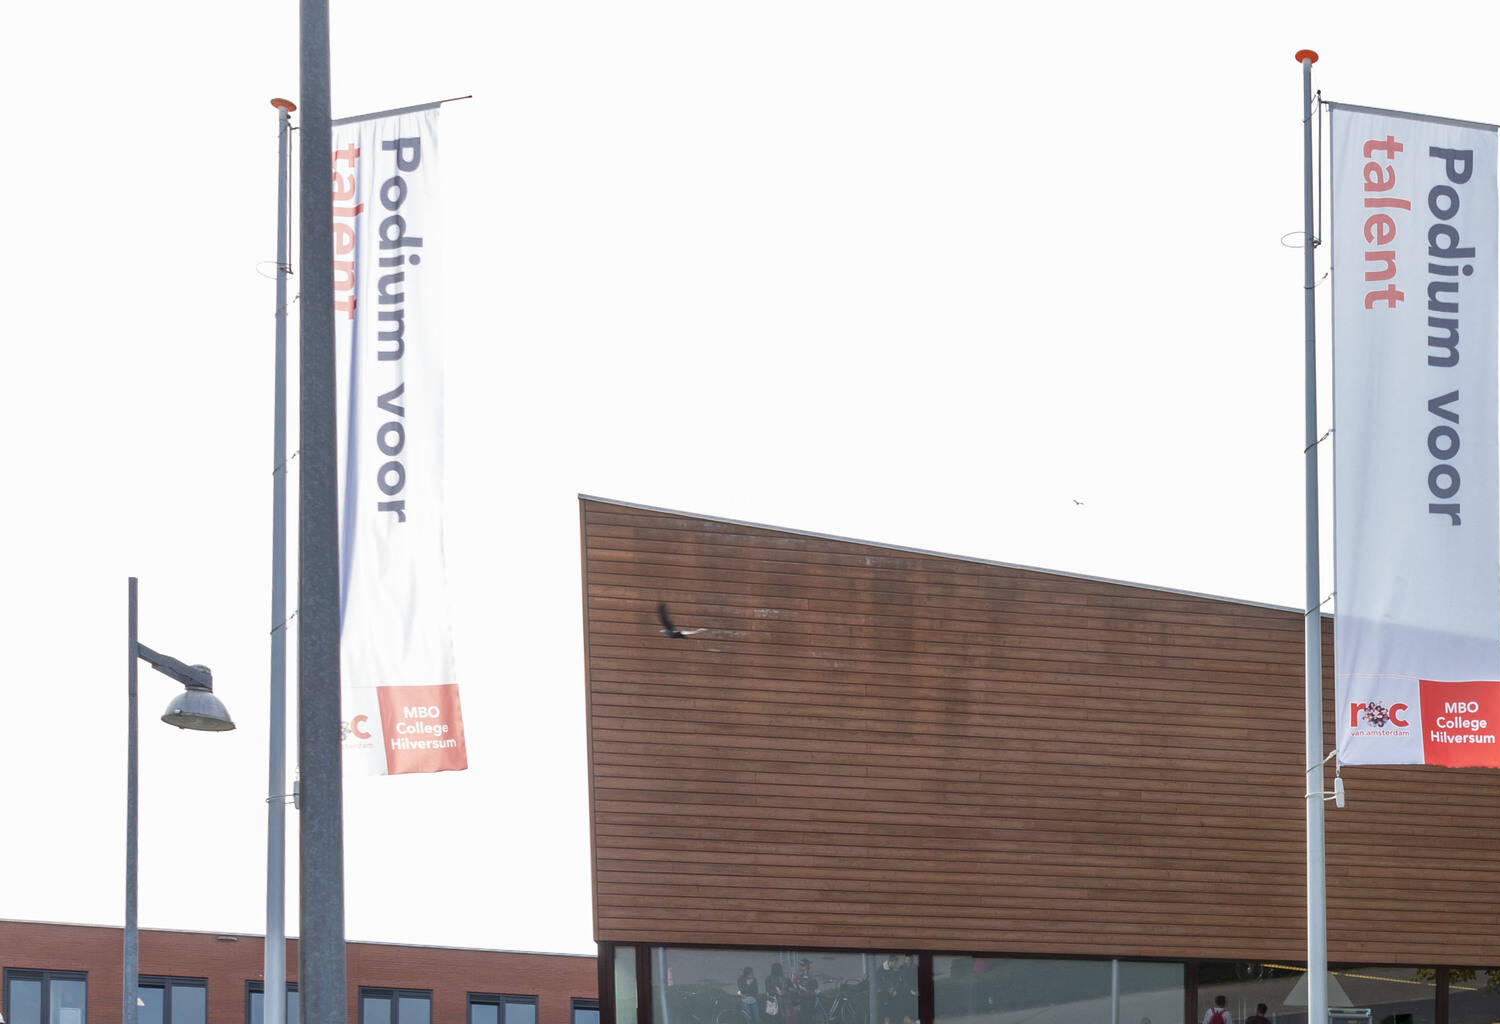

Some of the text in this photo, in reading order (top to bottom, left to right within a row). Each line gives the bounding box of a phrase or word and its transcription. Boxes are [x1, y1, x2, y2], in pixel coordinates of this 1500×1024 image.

[1363, 135, 1412, 310] talent
[332, 143, 364, 320] talent
[376, 137, 423, 523] Podium voor
[1428, 146, 1476, 526] Podium voor
[403, 706, 440, 719] MBO
[1444, 701, 1479, 714] MBO
[396, 722, 449, 736] College
[1436, 717, 1488, 732] College
[391, 737, 457, 750] Hilversum
[1430, 731, 1496, 744] Hilversum
